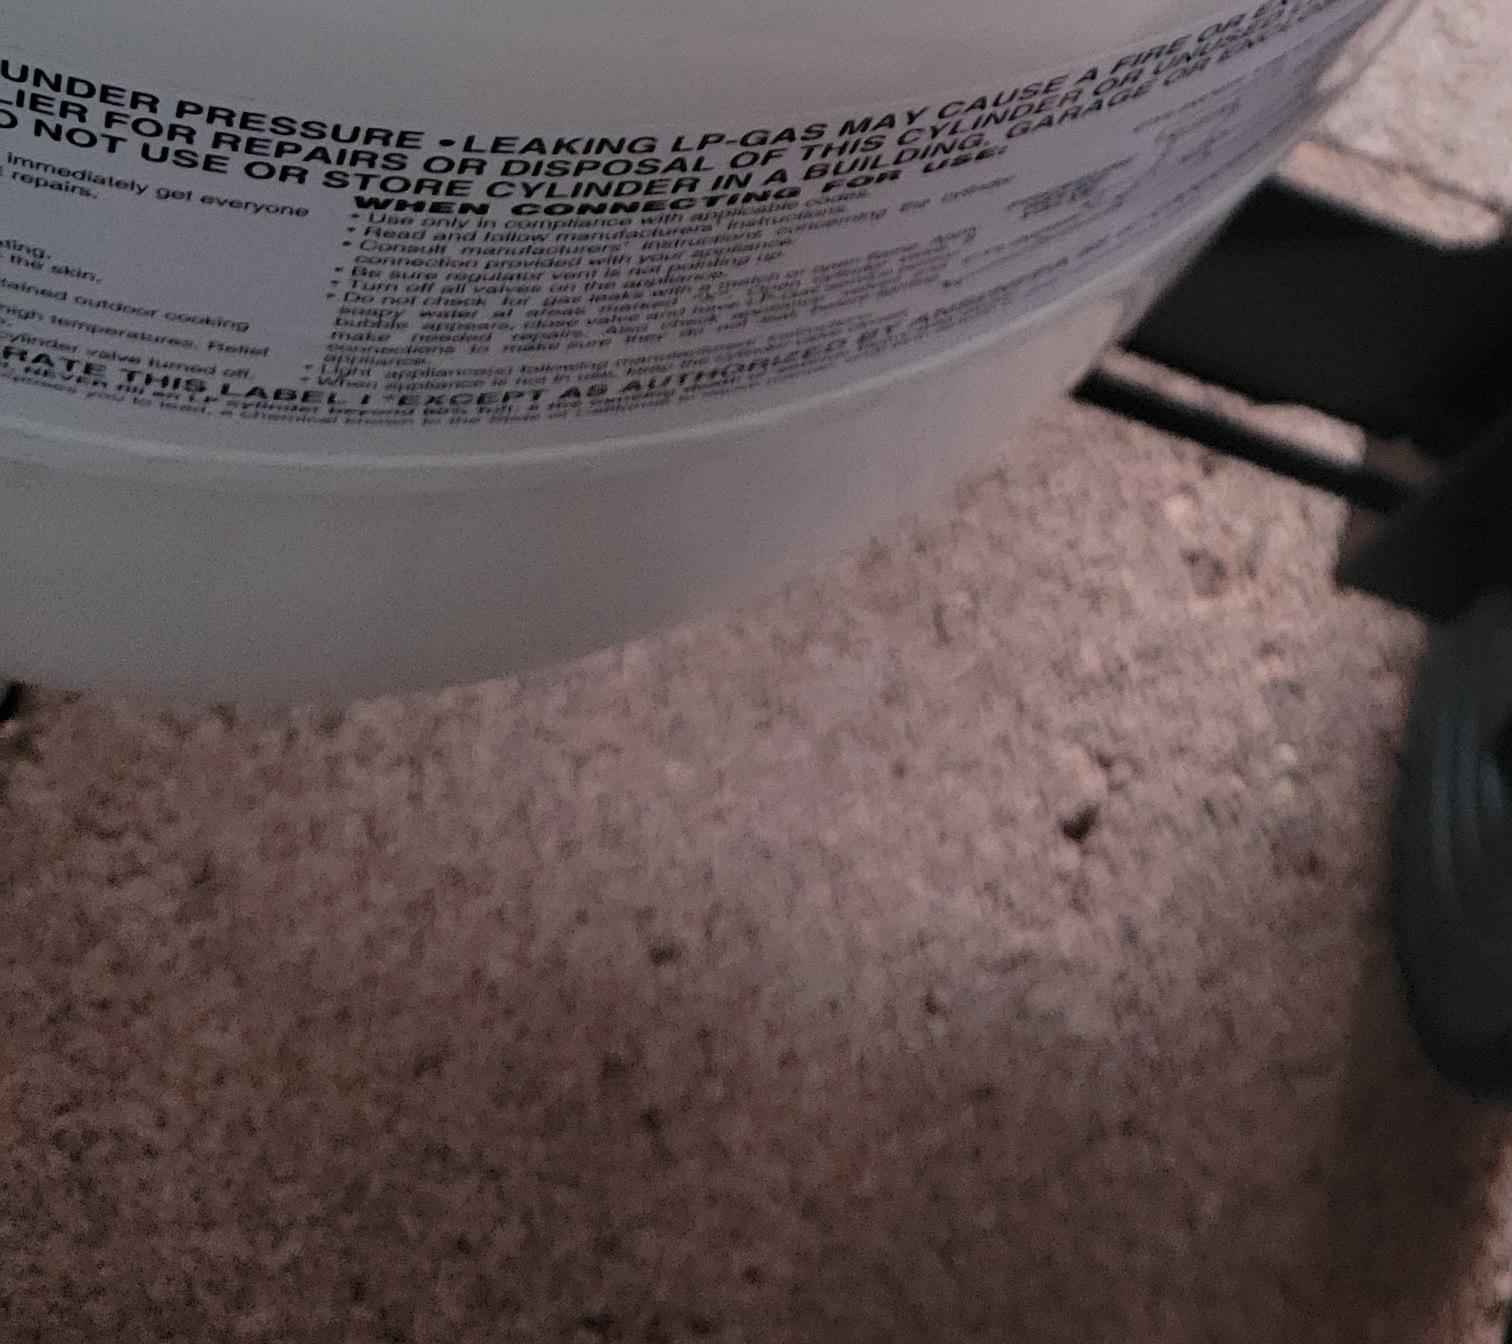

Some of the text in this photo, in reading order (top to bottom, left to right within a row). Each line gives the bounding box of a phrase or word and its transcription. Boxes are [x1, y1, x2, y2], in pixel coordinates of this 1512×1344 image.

[0, 60, 160, 114] UNDER
[175, 99, 425, 150] PRESSURE
[462, 135, 658, 155] LEAKING
[671, 123, 829, 152] LP-GAS
[839, 106, 929, 137] MAY
[937, 75, 1069, 120] CAUSE
[1075, 67, 1099, 84] A
[1110, 34, 1192, 75] FIRE
[34, 119, 128, 153] NOT
[141, 143, 231, 174] USE
[244, 161, 309, 185] OR
[322, 170, 473, 197] STORE
[486, 176, 700, 199] CYLINDER
[711, 172, 752, 192] IN
[762, 168, 788, 186] A
[1006, 78, 1155, 139] GARAGE
[104, 111, 197, 145] FOR
[212, 131, 408, 171] REPAIRS
[423, 155, 488, 177] OR
[499, 156, 715, 177] DISPOSAL
[730, 148, 789, 169] OF
[800, 135, 886, 161] THIS
[897, 88, 1083, 146] CYLINDER
[1093, 68, 1144, 97] OR
[7, 151, 310, 218] immediately get everyone
[12, 169, 98, 200] repairs.
[354, 196, 490, 216] WHEN
[510, 186, 801, 216] CONNECTING
[822, 170, 902, 193] FOR
